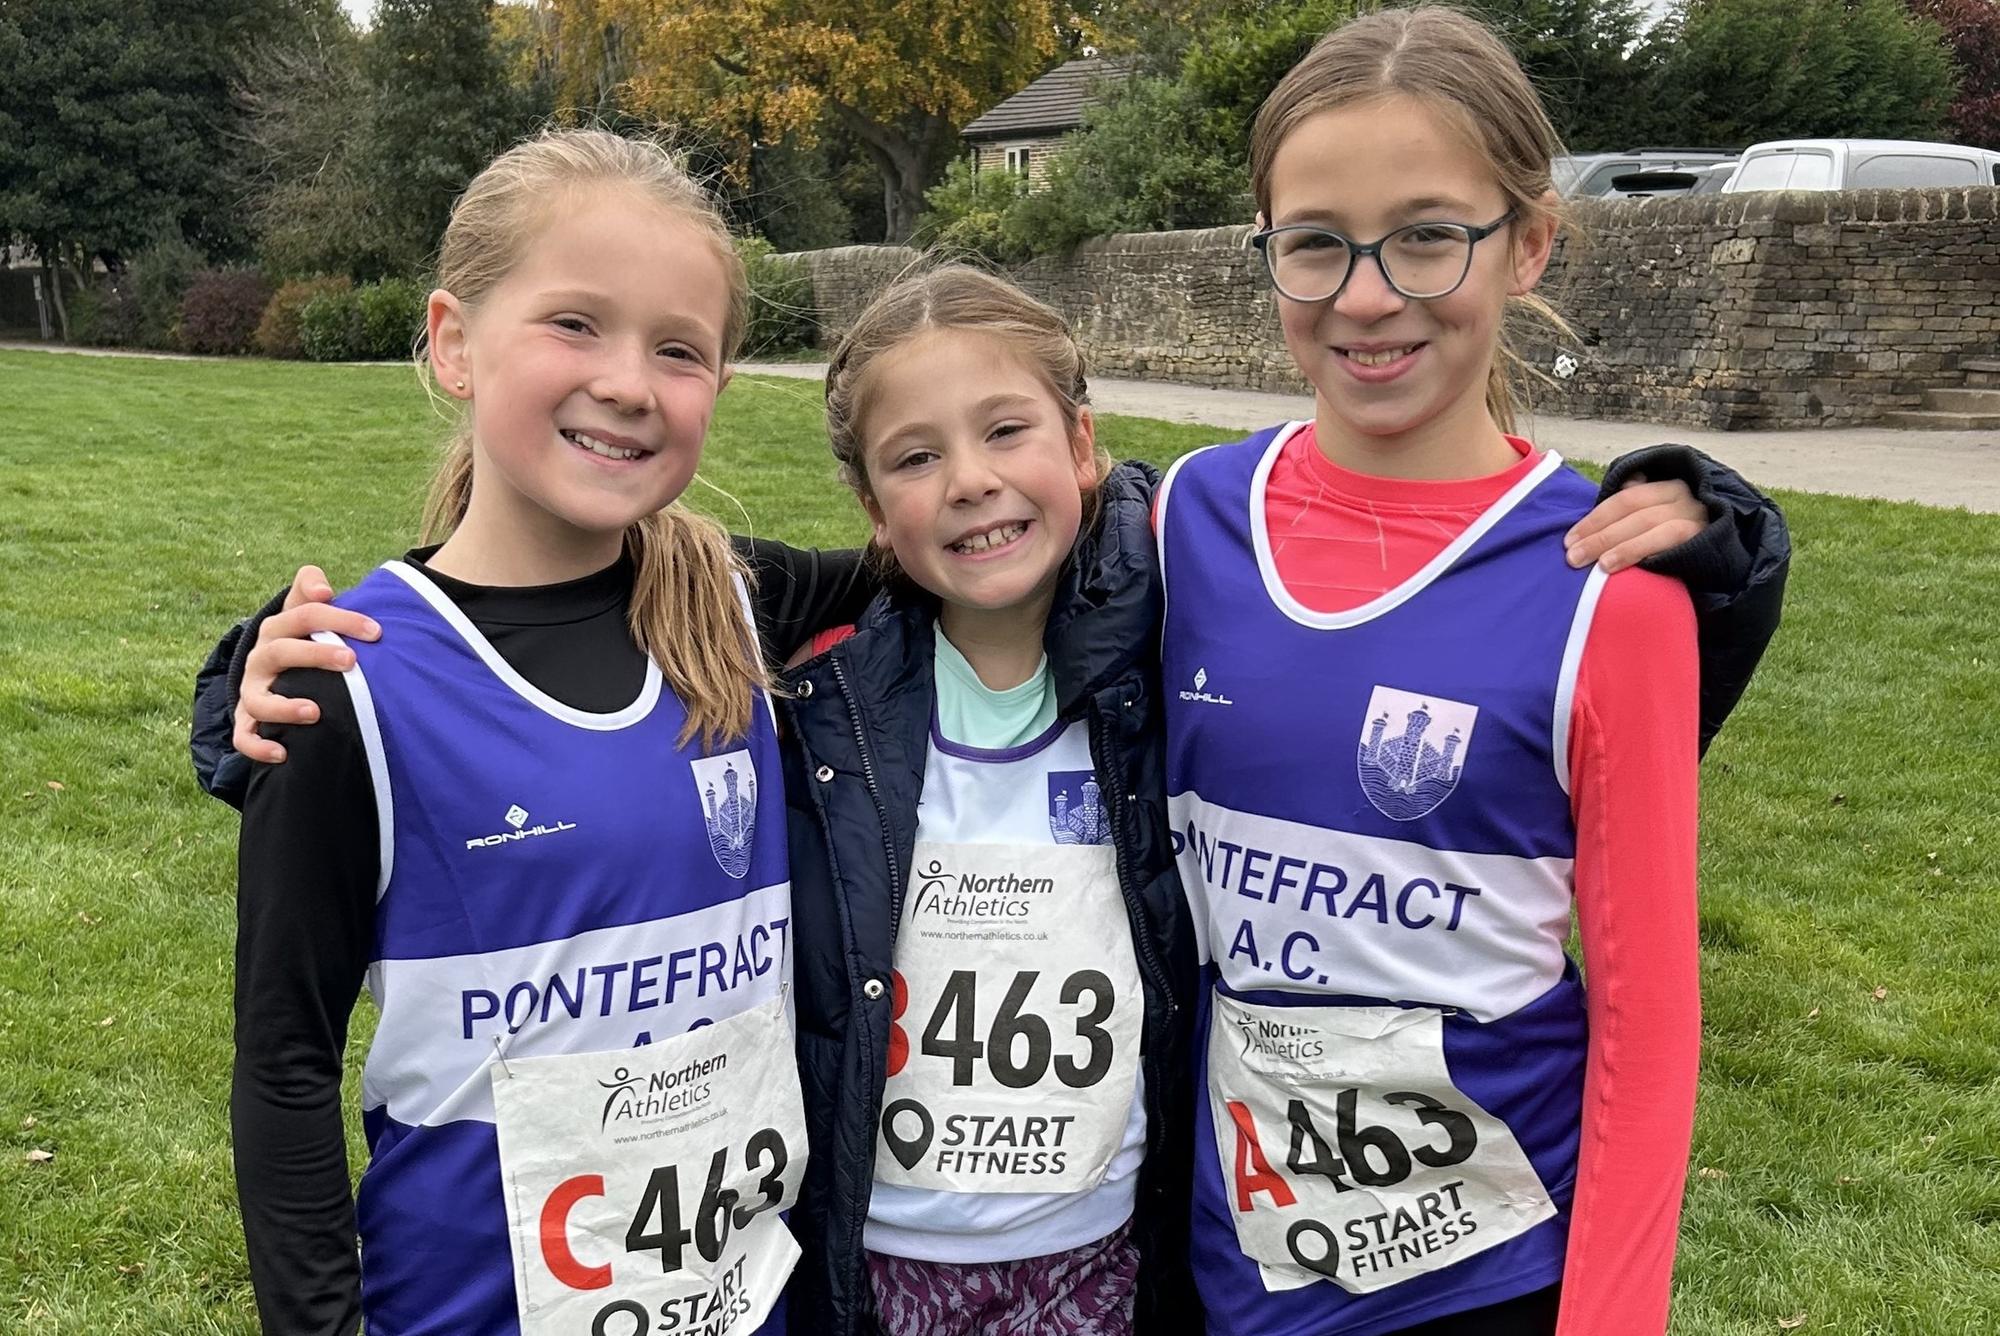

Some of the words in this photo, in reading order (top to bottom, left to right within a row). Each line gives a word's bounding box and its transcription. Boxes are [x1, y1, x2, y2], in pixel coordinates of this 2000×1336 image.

[1179, 691, 1233, 704] RONHILL
[466, 821, 576, 850] RONHILL
[924, 894, 1030, 916] Athletics
[957, 873, 1054, 893] Northern
[462, 917, 790, 1040] PONTEFRACT
[1228, 919, 1329, 985] A.C.
[921, 969, 1116, 1089] 463
[649, 1053, 727, 1093] Northern
[615, 1081, 711, 1121] Athletics
[941, 1114, 1075, 1148] START
[1226, 1100, 1297, 1212] A
[1286, 1088, 1477, 1194] 463
[936, 1151, 1067, 1175] FITNESS
[539, 1174, 614, 1291] C
[625, 1127, 788, 1274] 463
[1344, 1181, 1464, 1252] START
[1352, 1211, 1478, 1277] FITNESS
[658, 1252, 747, 1331] START
